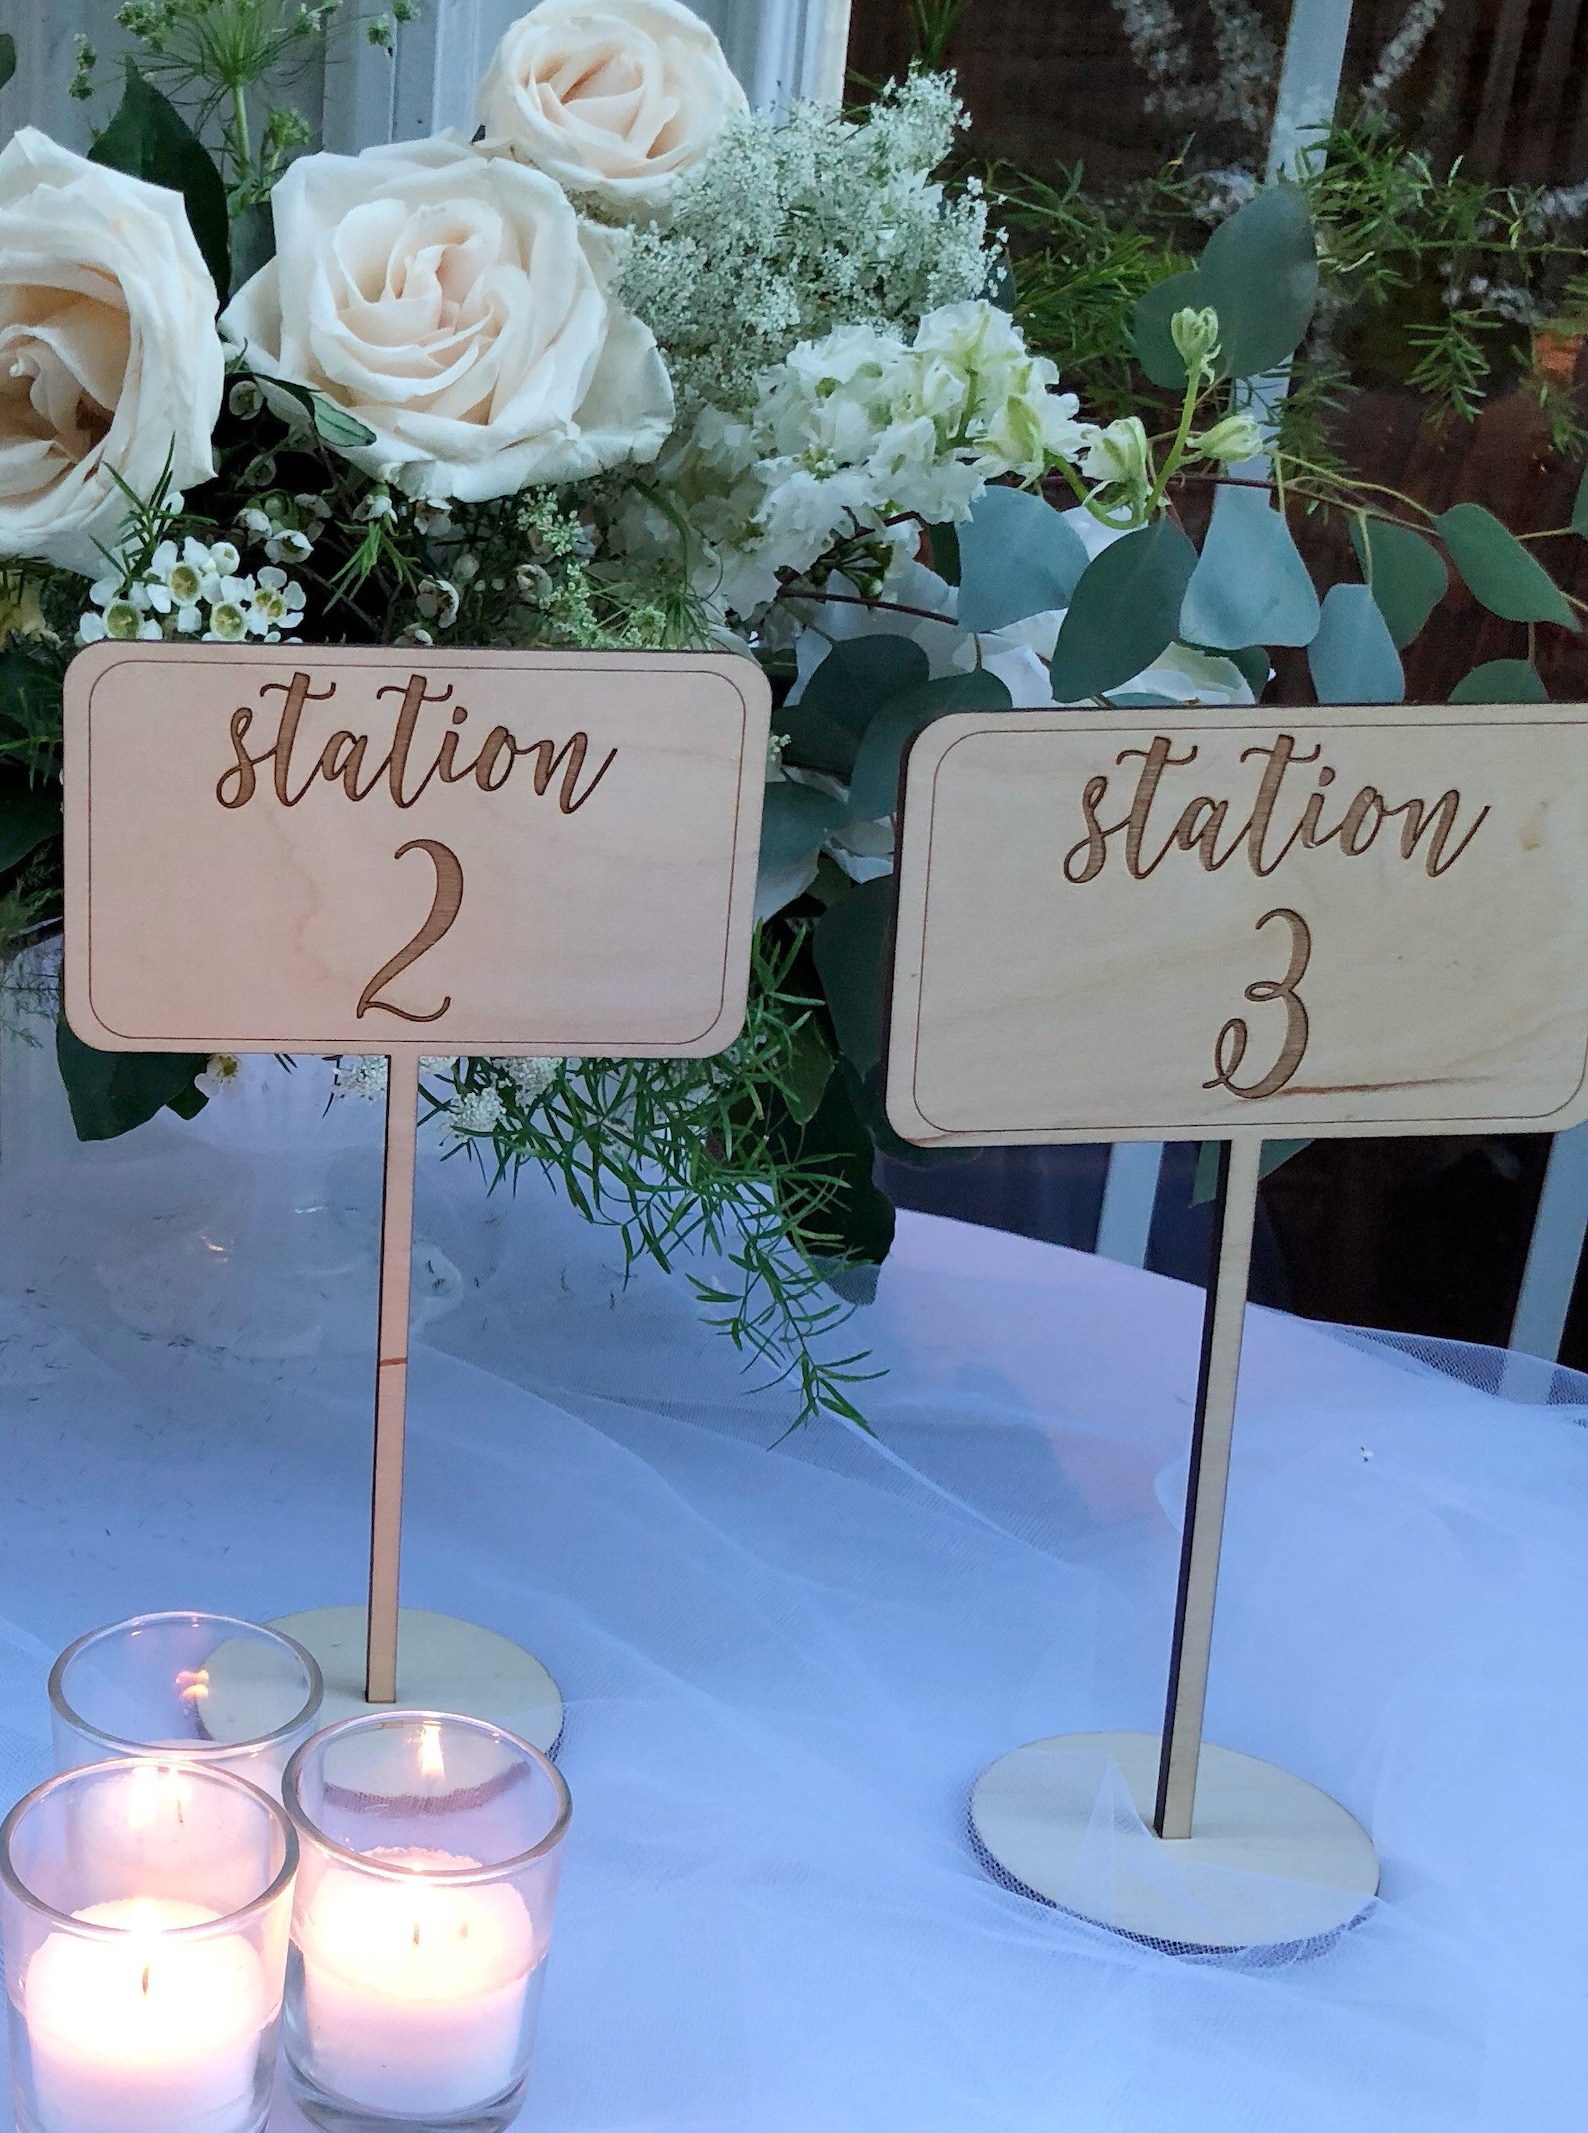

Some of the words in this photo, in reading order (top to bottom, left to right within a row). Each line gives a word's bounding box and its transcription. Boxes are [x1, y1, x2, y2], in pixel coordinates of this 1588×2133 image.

[216, 672, 618, 814] station
[1063, 734, 1491, 884] station
[356, 838, 464, 1023] 2
[1202, 908, 1312, 1099] 3
